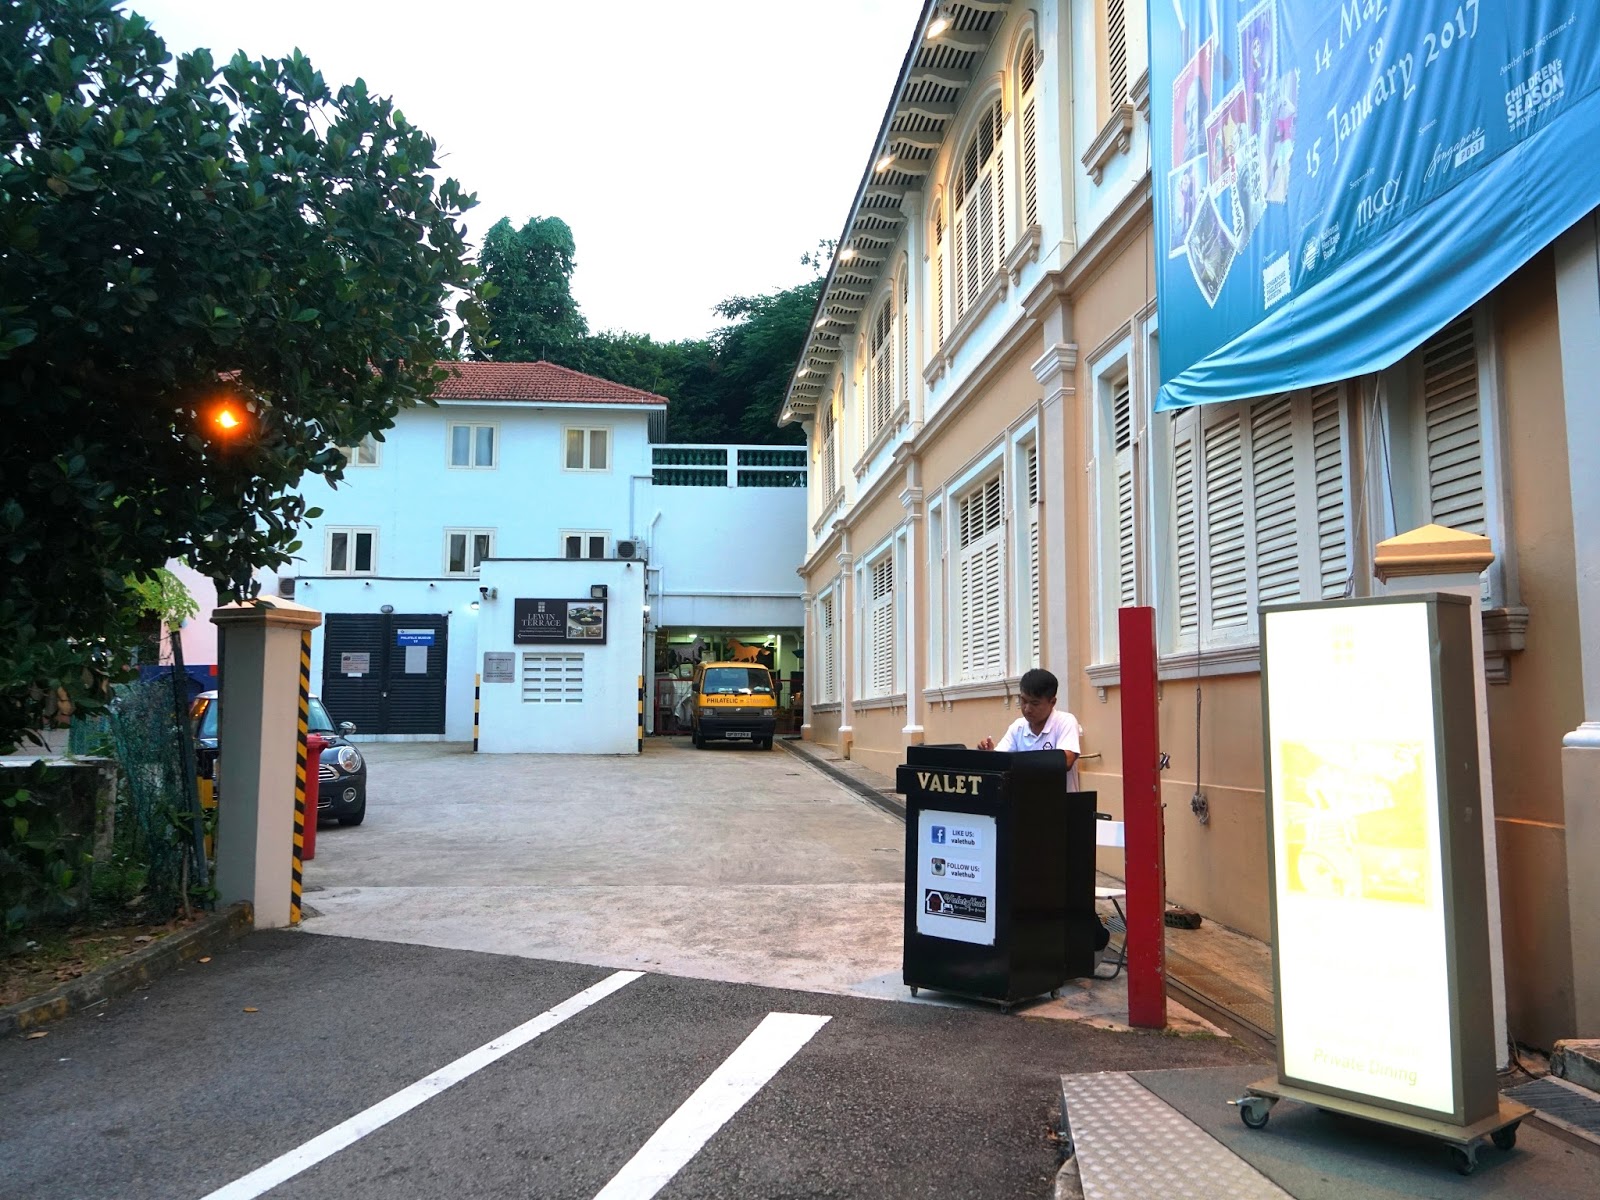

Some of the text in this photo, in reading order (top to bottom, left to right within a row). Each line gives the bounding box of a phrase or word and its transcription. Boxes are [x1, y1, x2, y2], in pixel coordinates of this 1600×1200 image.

[1315, 37, 1333, 75] 14
[1368, 37, 1384, 64] to
[1306, 136, 1322, 178] 15
[1326, 53, 1416, 165] January
[1423, 0, 1480, 68] 2017
[1506, 69, 1565, 124] SEASON
[1423, 126, 1486, 183] Singapore
[1460, 139, 1483, 162] POST
[521, 619, 562, 627] TERRACE
[527, 613, 556, 621] LEWIN
[917, 772, 982, 796] VALET
[951, 838, 976, 846] valethub
[947, 863, 969, 871] FOLLOW
[951, 871, 976, 879] valethub
